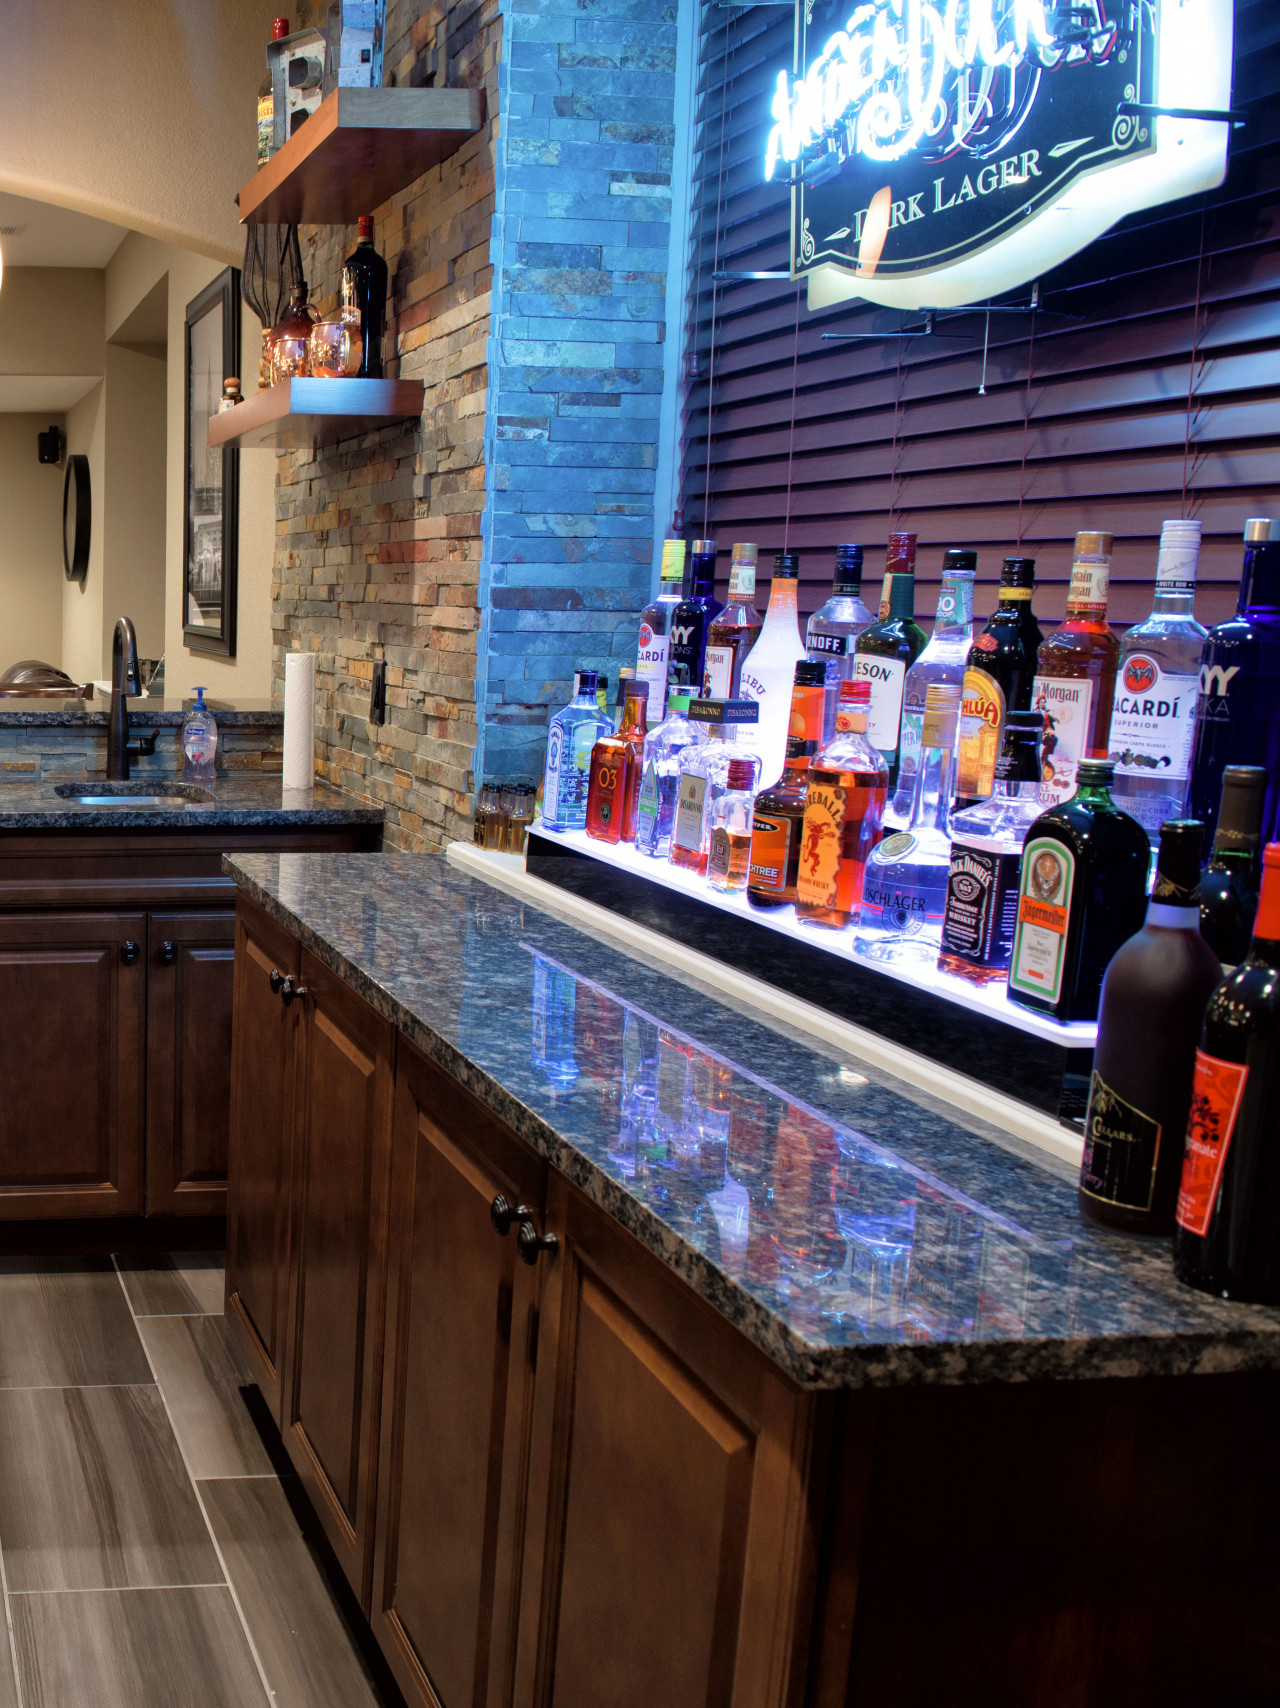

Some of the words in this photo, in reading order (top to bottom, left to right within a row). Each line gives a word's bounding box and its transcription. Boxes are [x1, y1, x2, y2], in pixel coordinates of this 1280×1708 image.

[853, 192, 926, 242] DRK
[932, 149, 1043, 213] LAGER
[636, 649, 665, 662] ARDÍ
[857, 661, 892, 682] ESON
[1040, 683, 1079, 702] Morgan
[691, 705, 721, 716] DISARONNO
[727, 708, 757, 717] DISARONNO
[1113, 696, 1180, 718] ACARDÍ
[1114, 719, 1159, 729] SUPERIOR
[949, 911, 977, 926] WHISKEY
[1092, 1115, 1134, 1142] CELLARS
